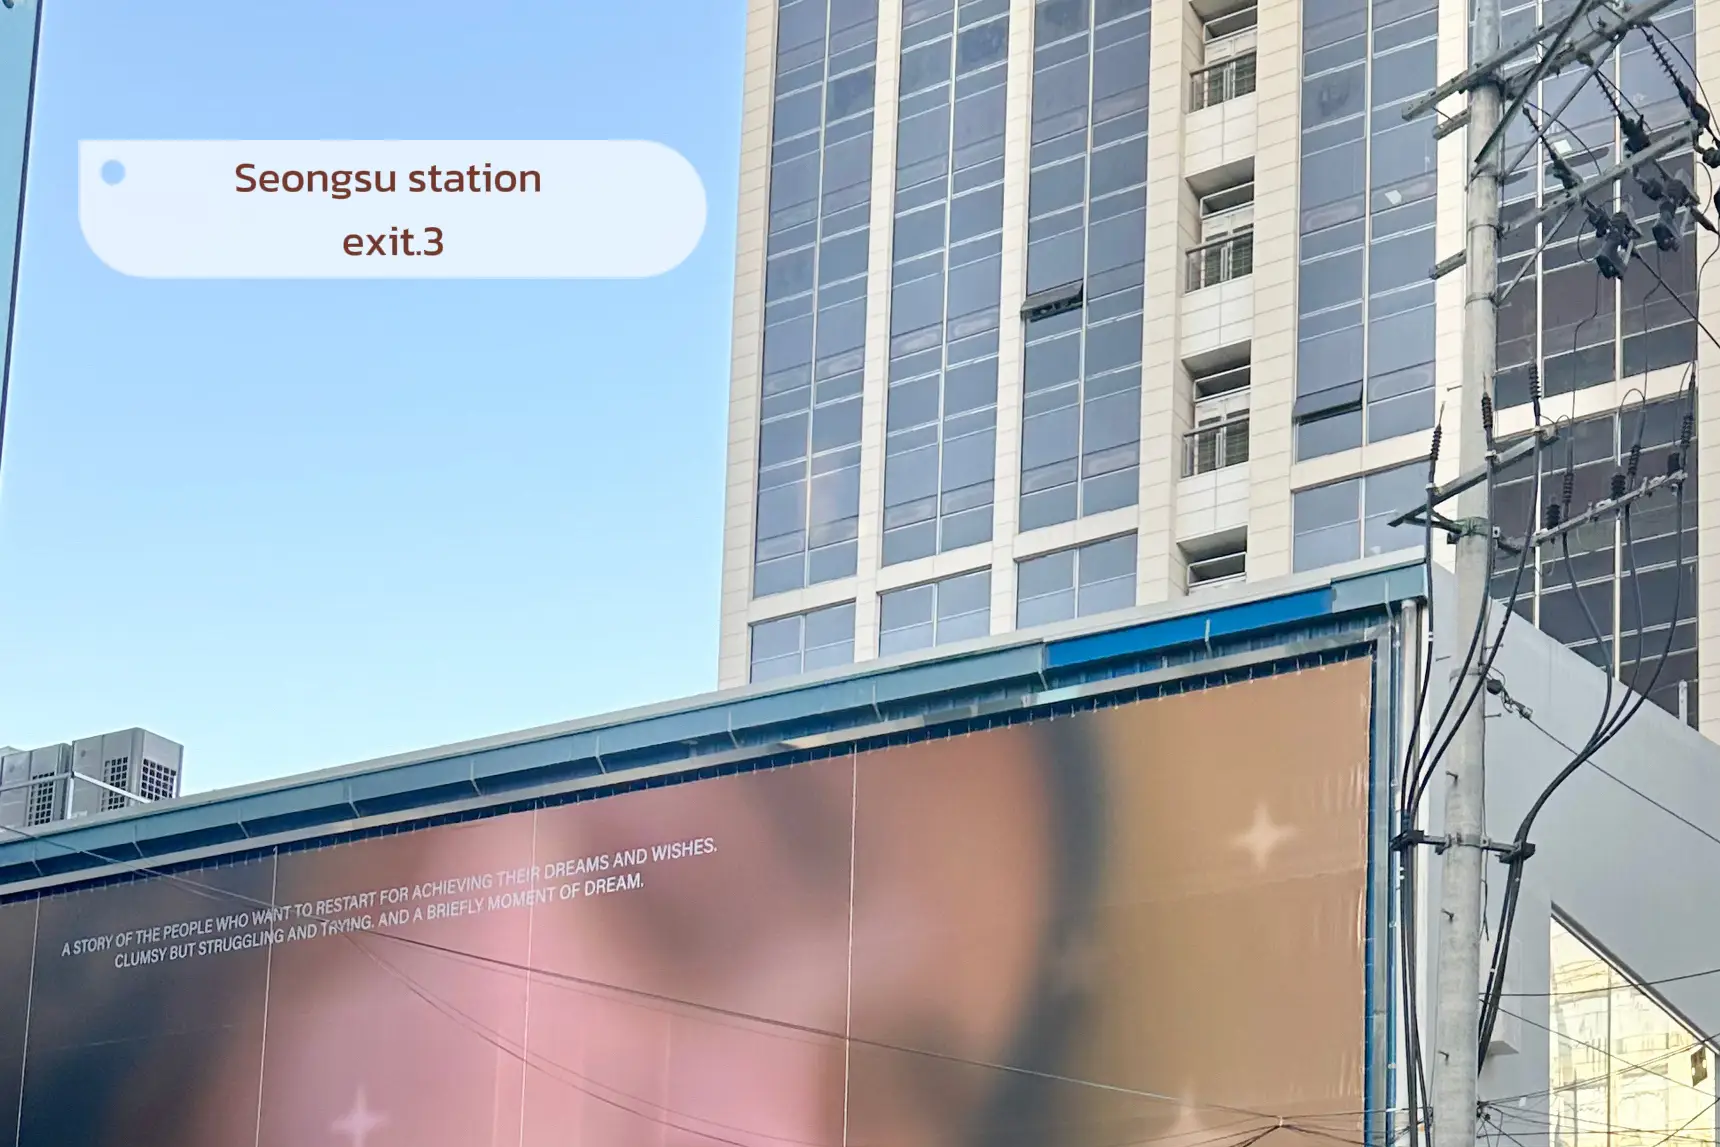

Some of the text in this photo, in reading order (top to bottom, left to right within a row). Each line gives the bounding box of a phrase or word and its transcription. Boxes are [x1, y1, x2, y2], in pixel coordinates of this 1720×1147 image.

[62, 836, 718, 956] A STORY OF THE PEOPLE WHO WANT TO RESTART FOR ACHIEVING THEIR DREAMS AND WISHES.
[114, 872, 645, 968] CLUMSY BUT STRUGGLING AND TRYING. AND A BRIEFLY MOMENT OF DREAM.
